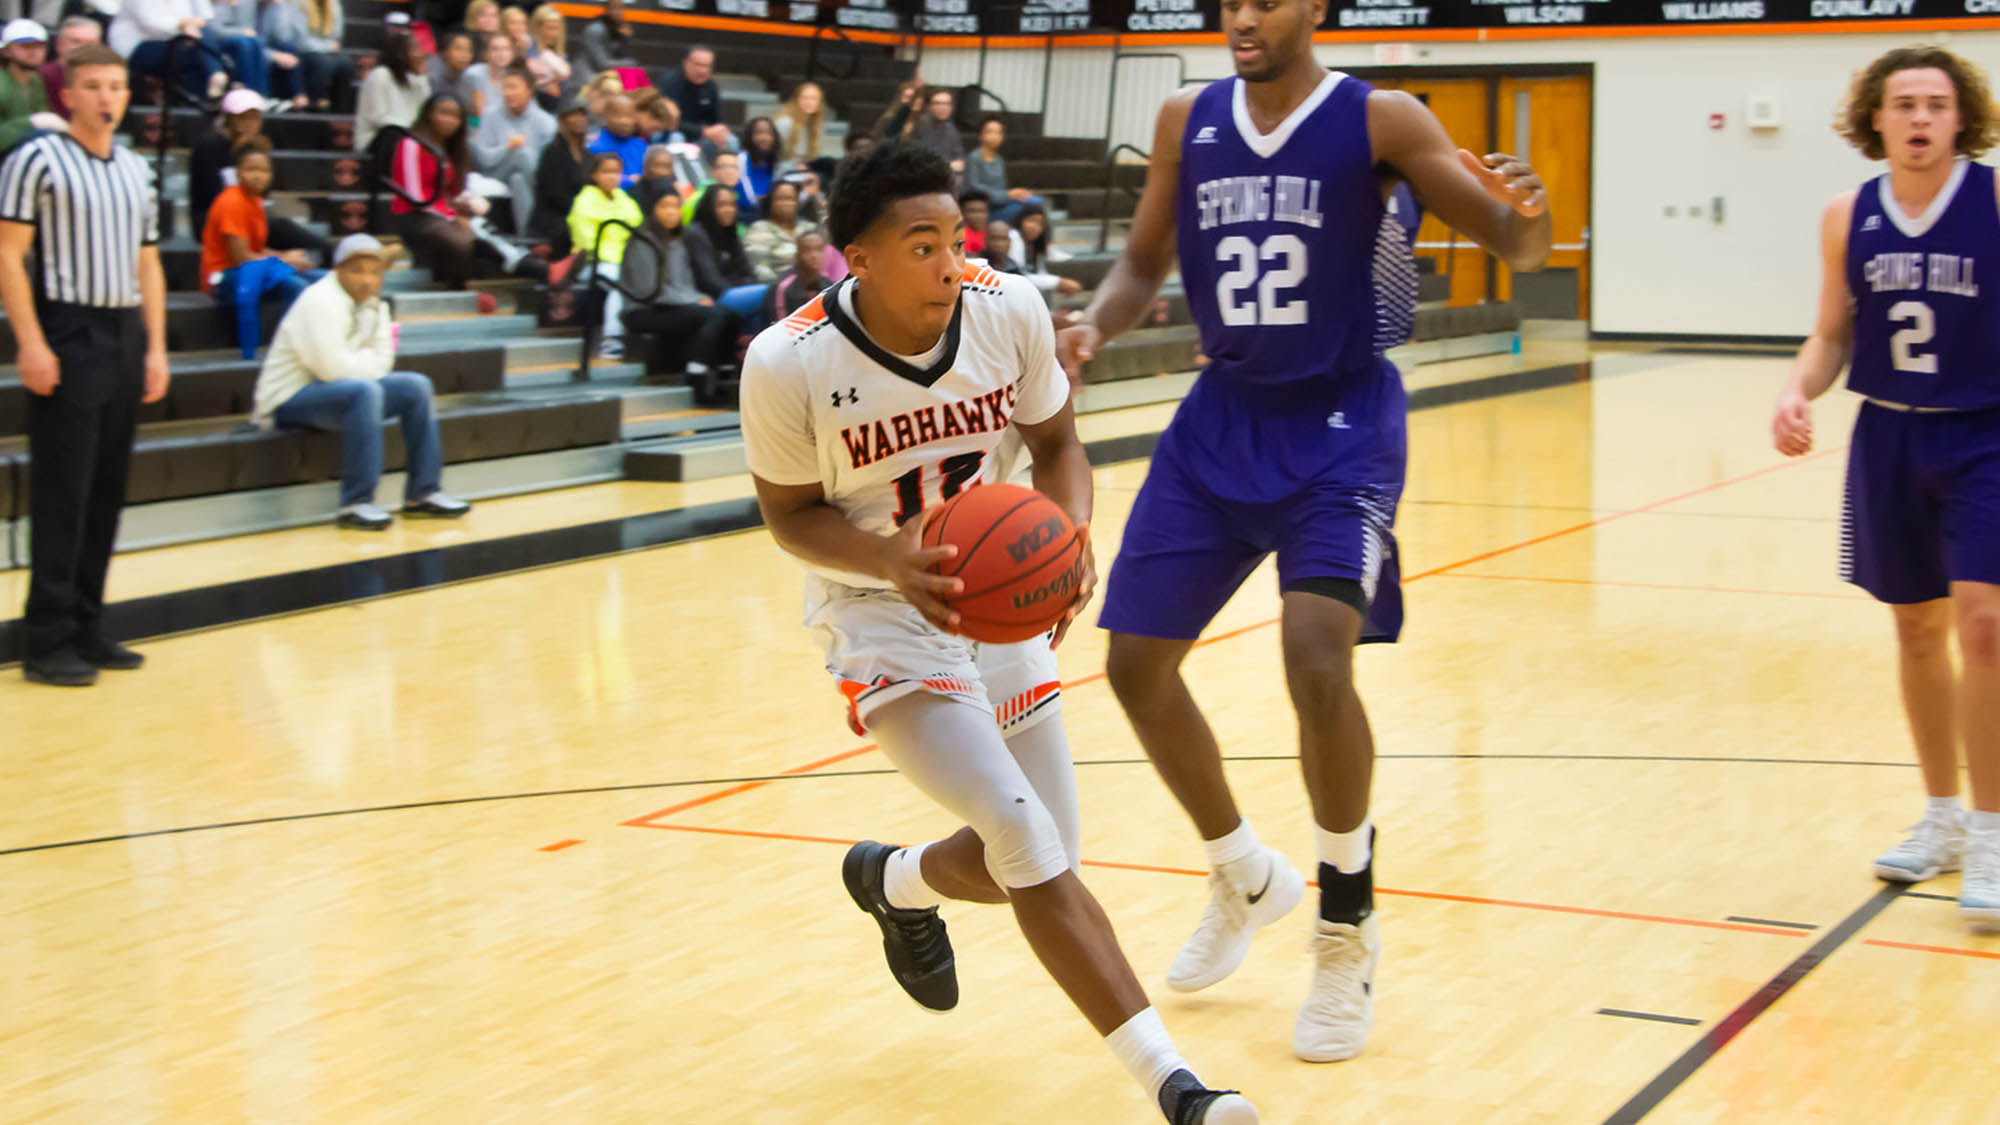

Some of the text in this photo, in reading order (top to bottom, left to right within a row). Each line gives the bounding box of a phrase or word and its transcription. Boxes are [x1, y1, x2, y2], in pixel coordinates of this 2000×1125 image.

[1128, 13, 1204, 31] OLSSON
[1339, 7, 1430, 26] BARNETT
[1504, 5, 1584, 24] WILSON
[1662, 1, 1765, 20] WILLIAMS
[1273, 175, 1325, 229] HILL
[1216, 235, 1308, 326] 22
[1926, 252, 1979, 297] HILL
[1888, 300, 1939, 374] 2
